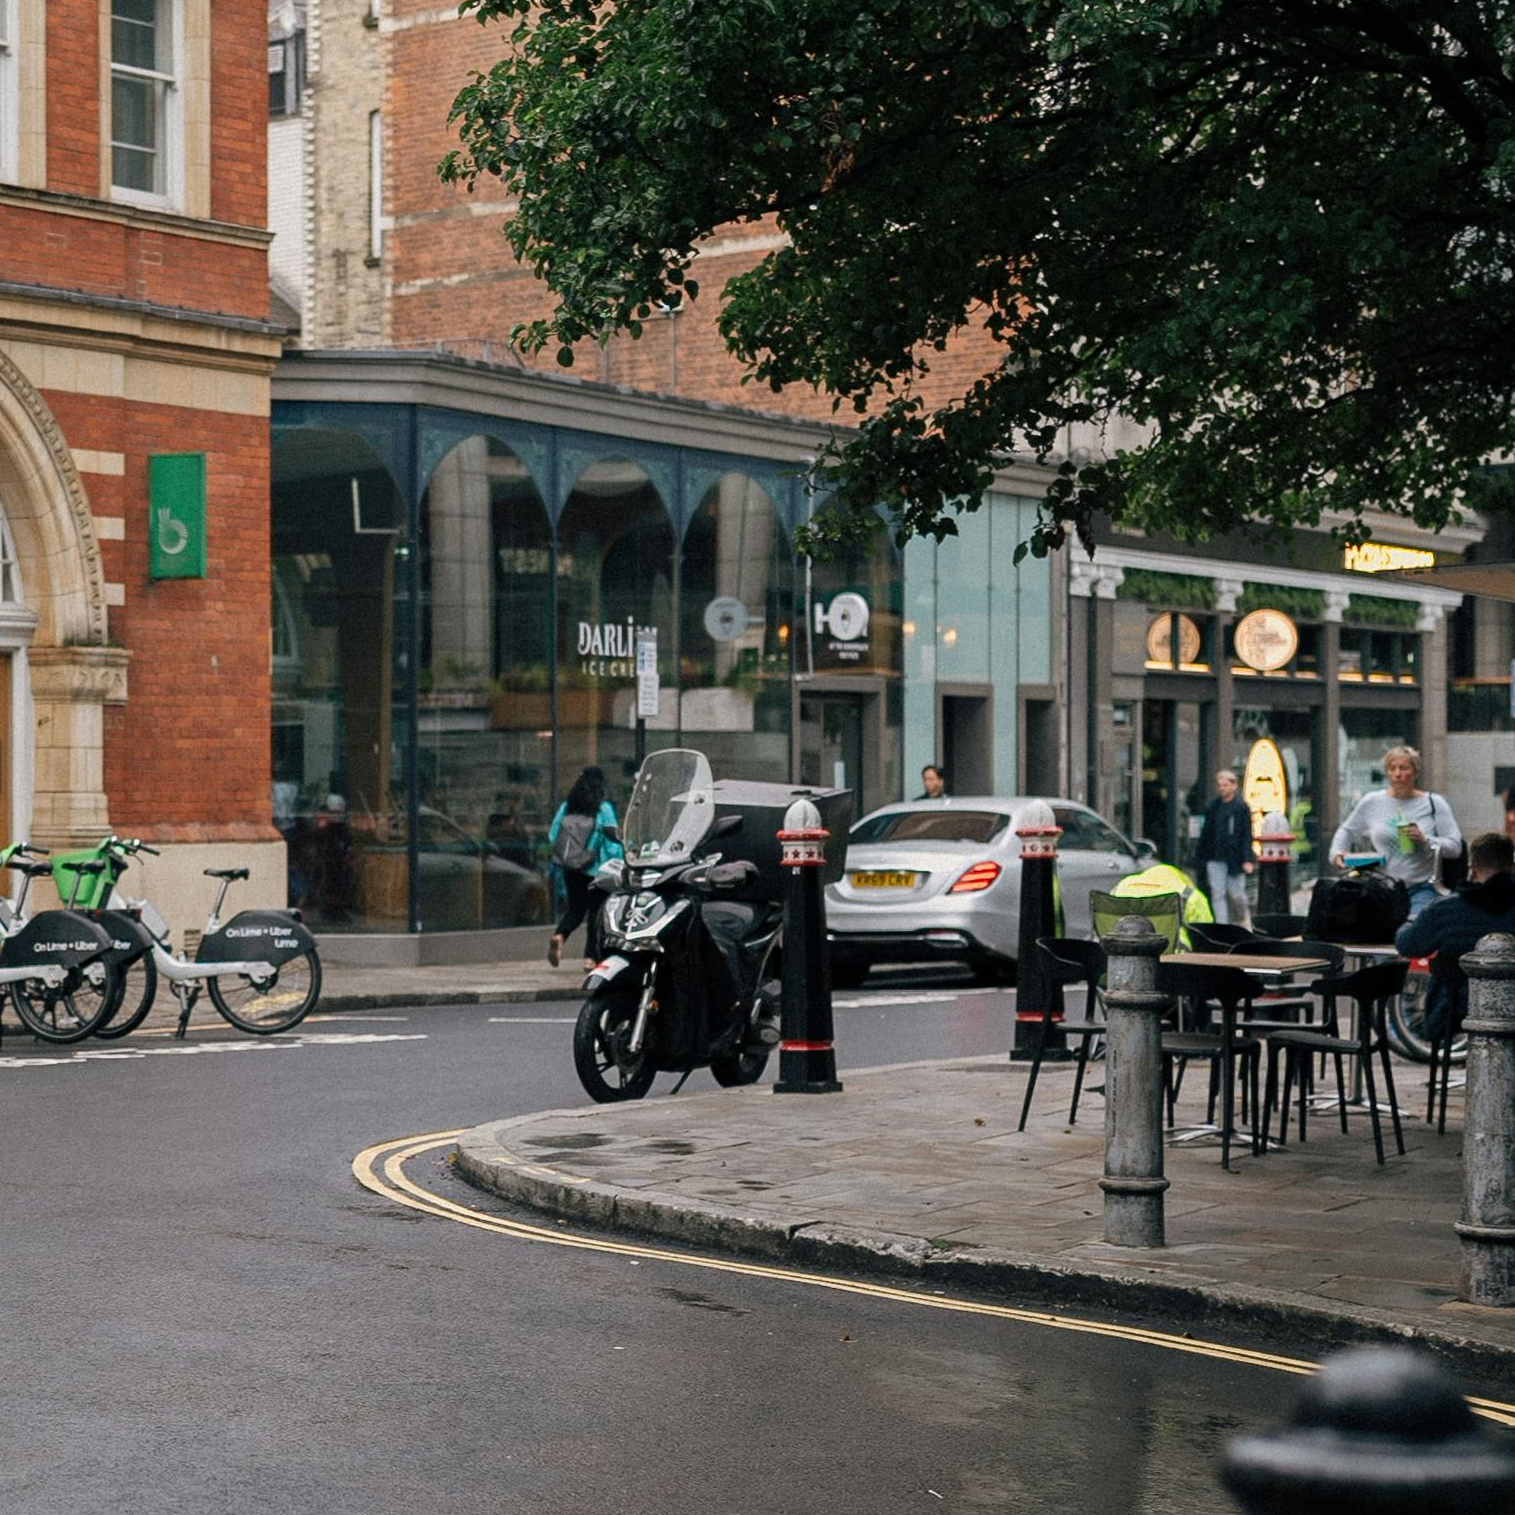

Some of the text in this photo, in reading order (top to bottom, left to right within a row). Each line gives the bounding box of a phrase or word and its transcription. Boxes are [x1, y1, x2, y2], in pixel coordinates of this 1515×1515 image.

[582, 660, 635, 678] ICE CRE
[226, 928, 240, 938] On
[241, 927, 262, 937] Lime
[269, 926, 293, 937] Uber
[34, 942, 47, 952] On
[47, 941, 68, 952] Lime
[74, 940, 98, 951] Uber
